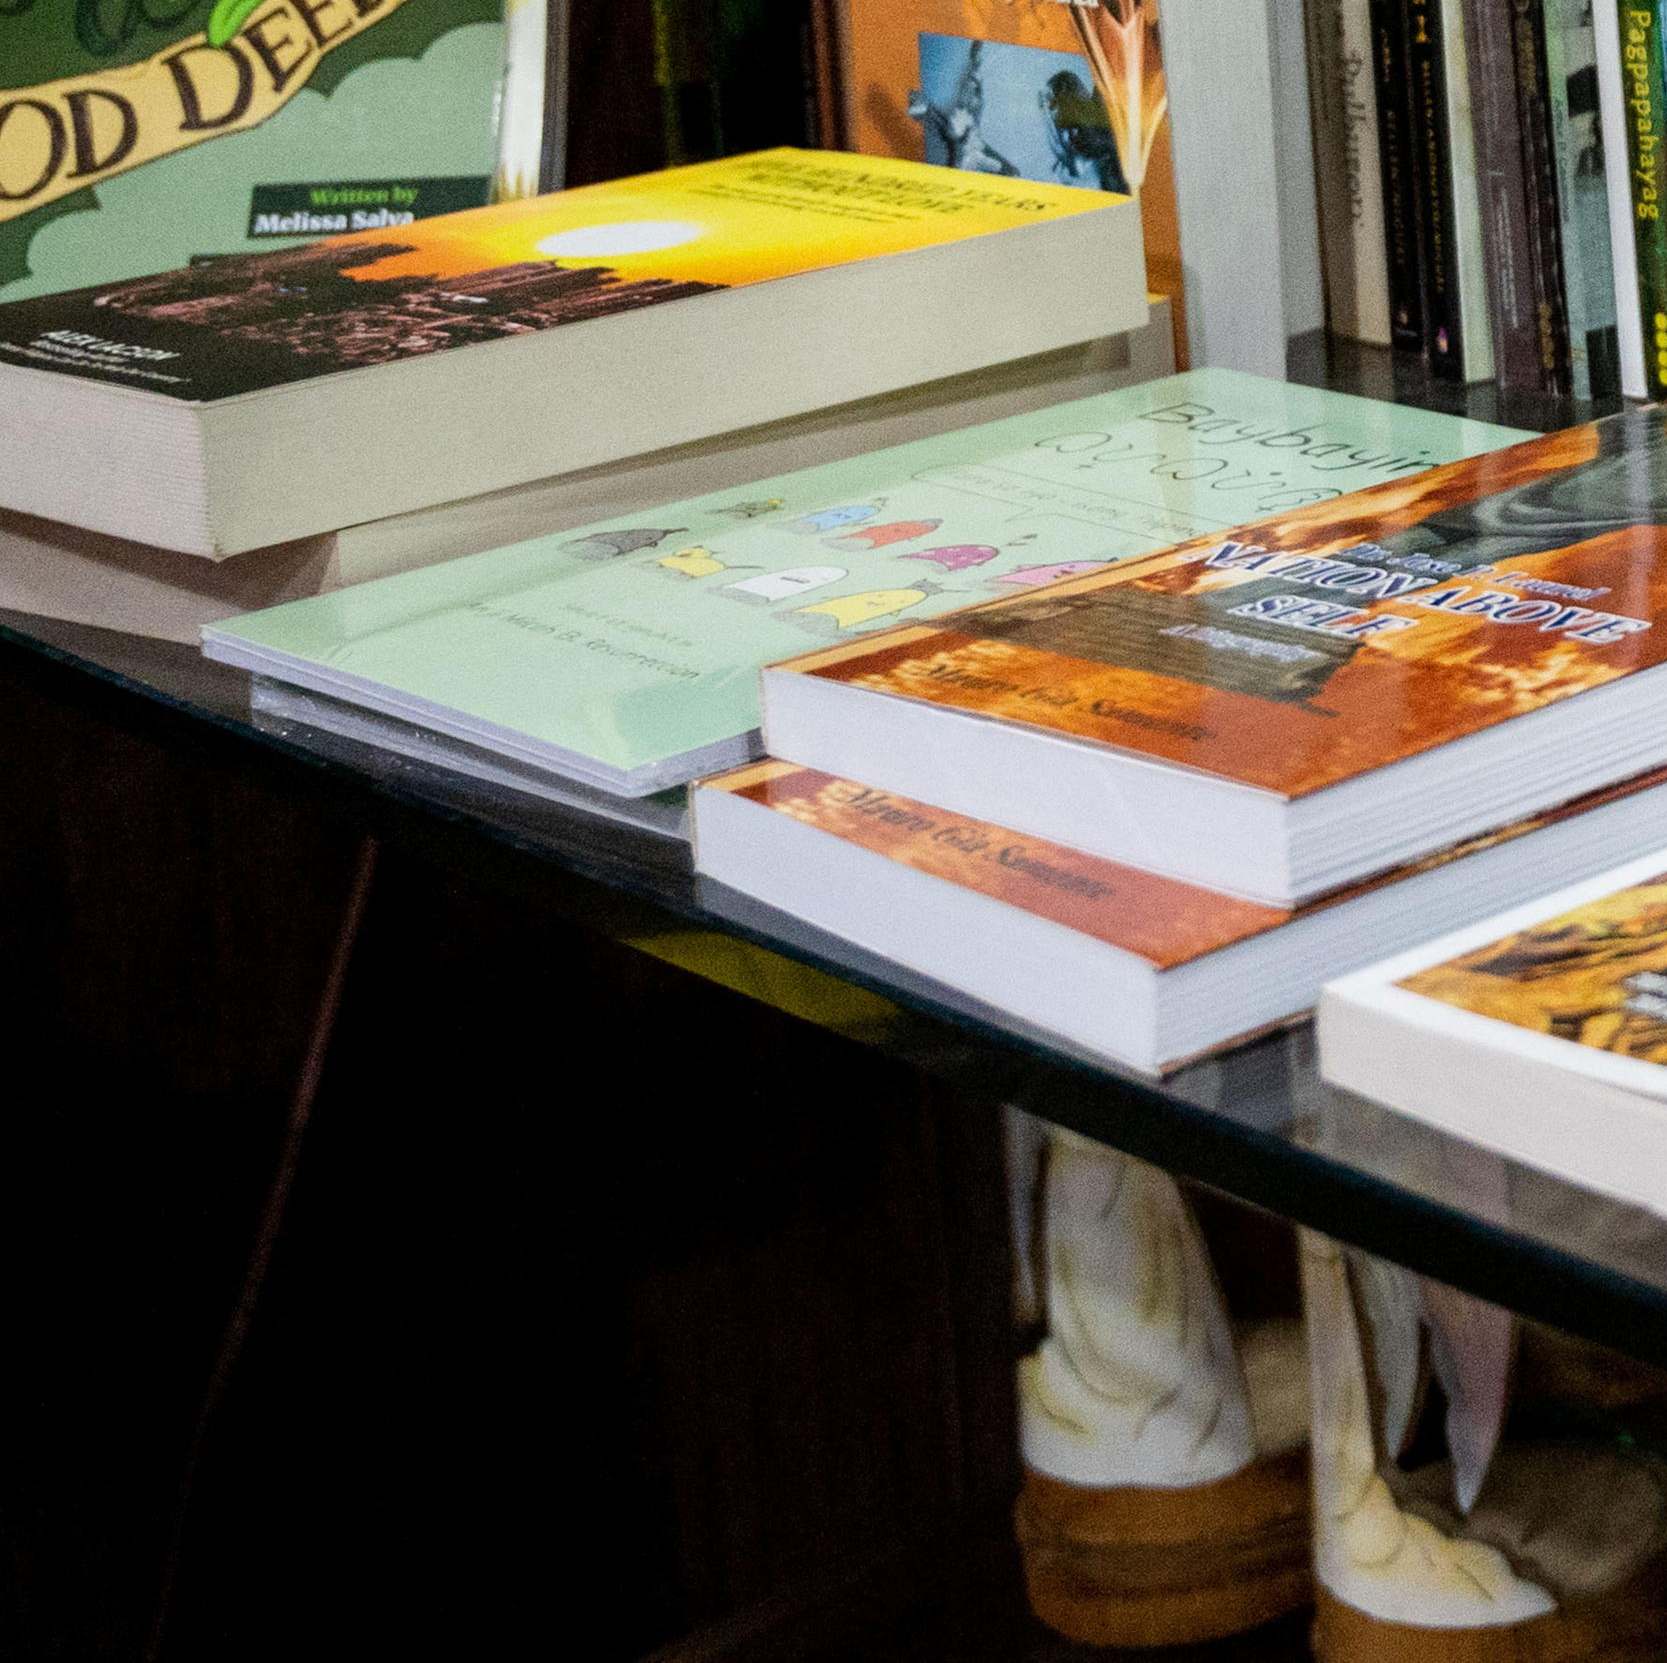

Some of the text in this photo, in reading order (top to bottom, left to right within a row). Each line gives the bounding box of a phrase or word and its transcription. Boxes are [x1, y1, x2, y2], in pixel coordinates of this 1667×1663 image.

[1620, 9, 1666, 219] Pagpapahayag
[310, 186, 419, 208] Written by
[254, 212, 345, 234] Melissa
[1181, 542, 1437, 599] NATION
[1394, 586, 1652, 645] ABOVE
[1229, 595, 1419, 639] SELF
